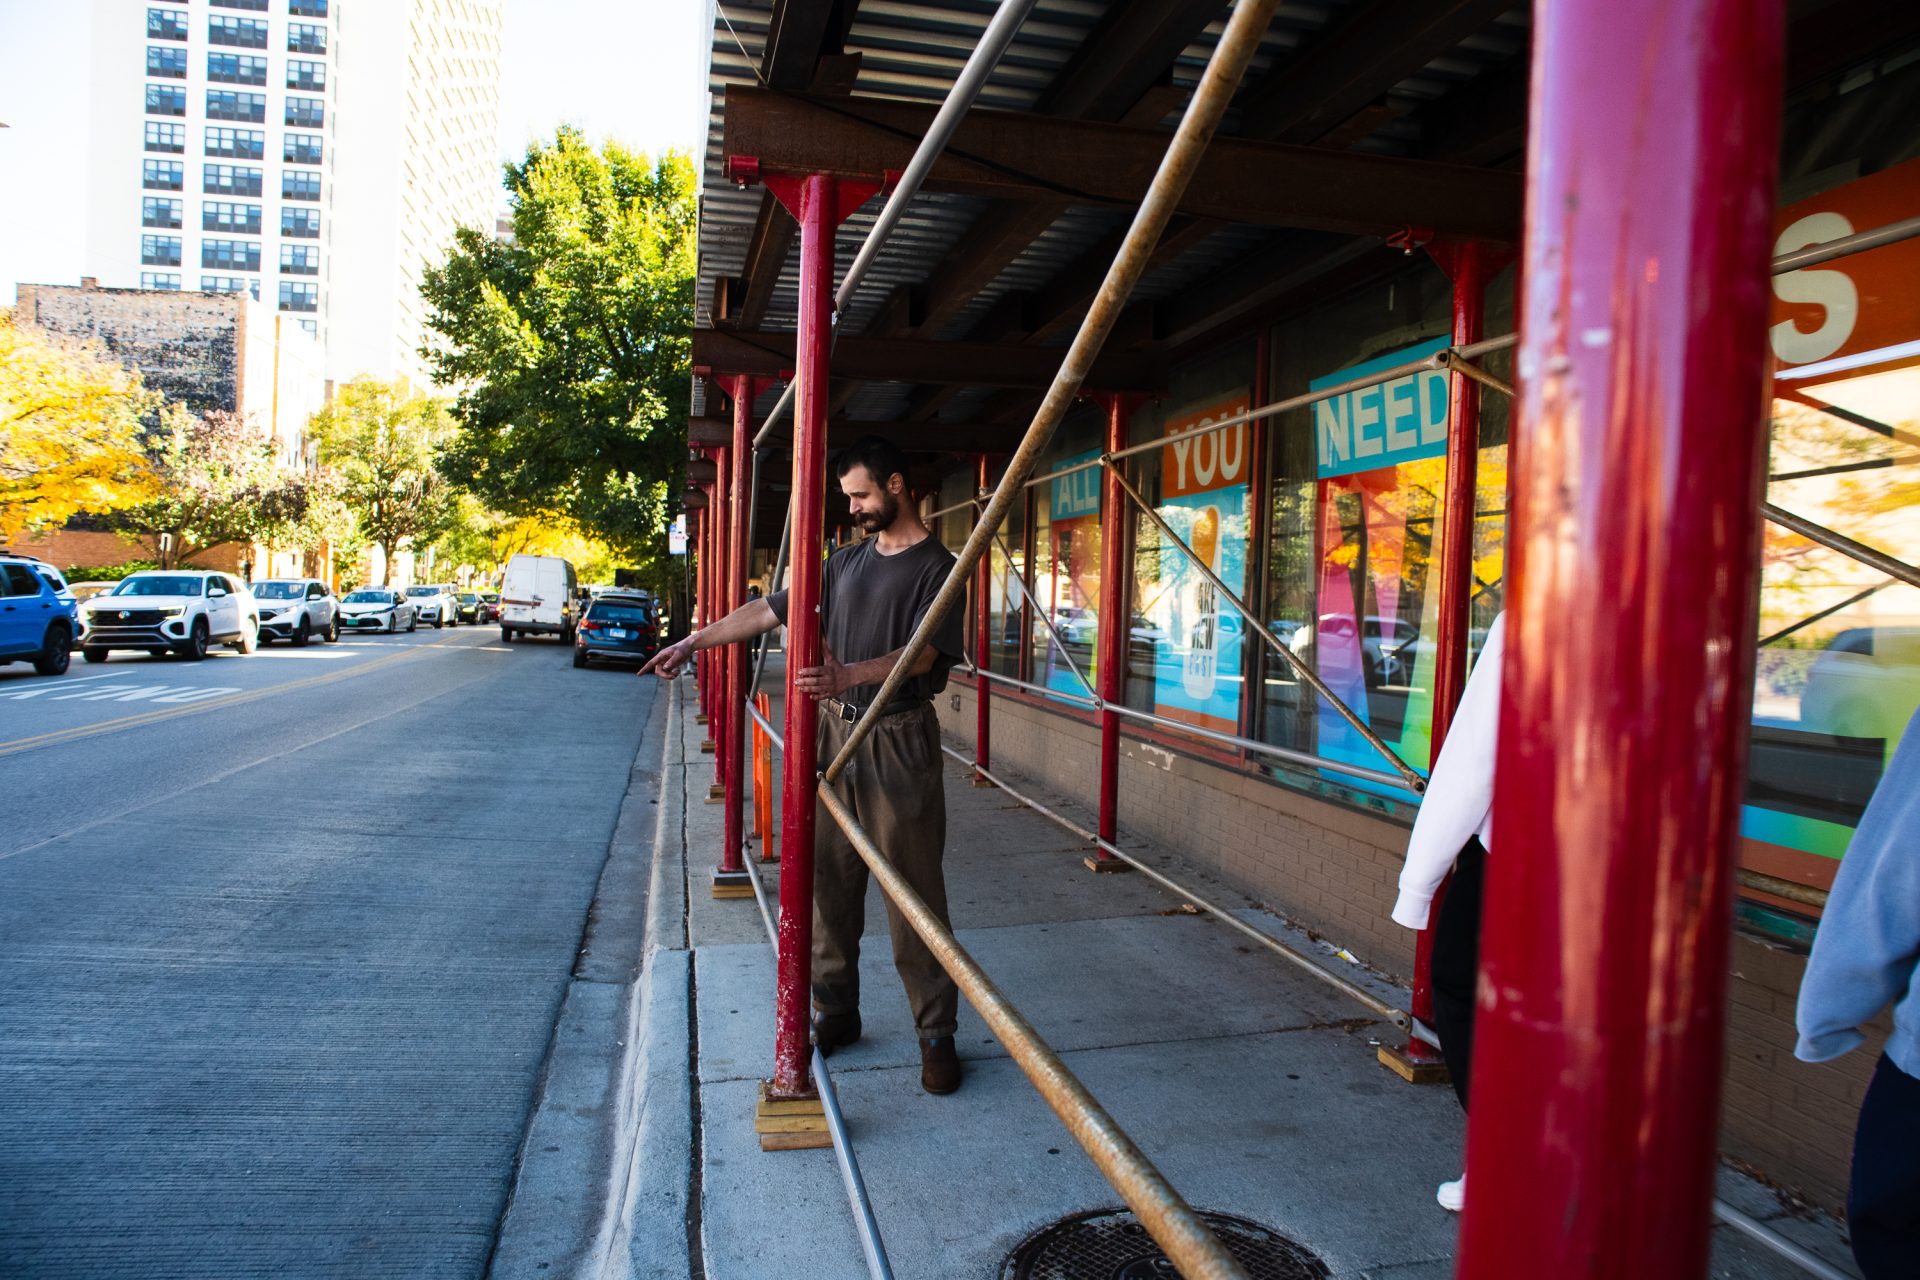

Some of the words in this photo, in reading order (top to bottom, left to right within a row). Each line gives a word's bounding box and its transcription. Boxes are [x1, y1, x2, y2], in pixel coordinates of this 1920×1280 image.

[1057, 458, 1098, 515] ALL
[1169, 406, 1245, 490] YOU
[1316, 366, 1451, 466] NEED
